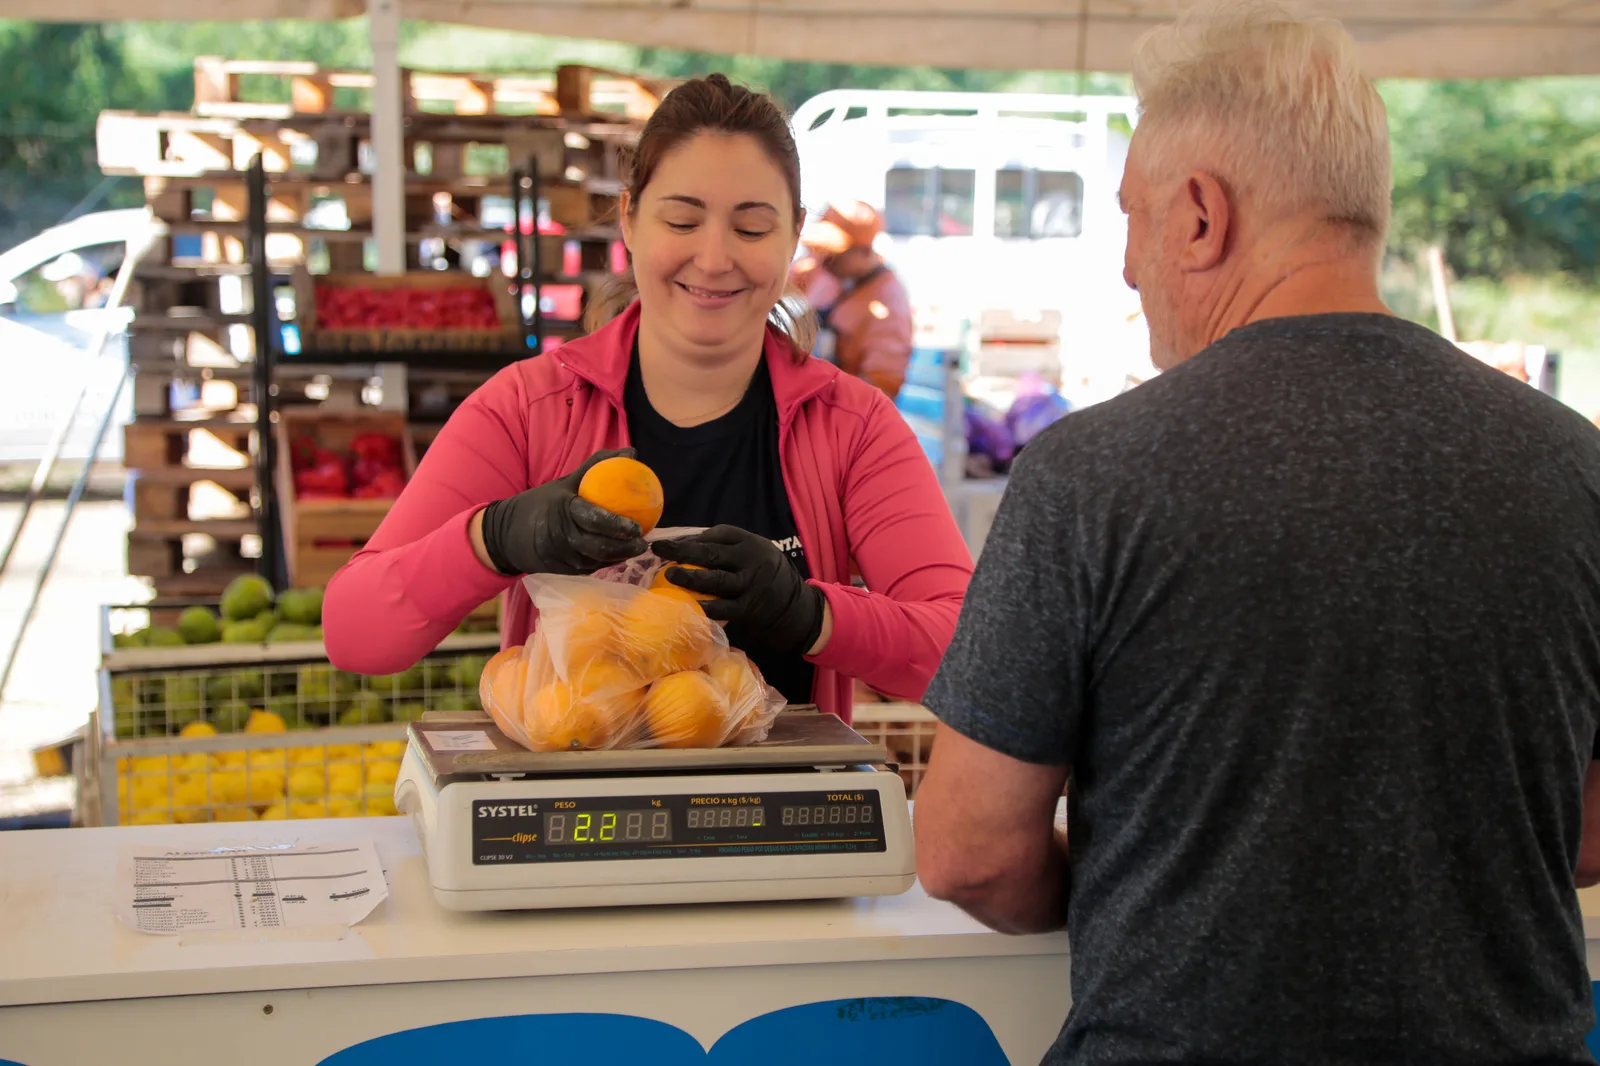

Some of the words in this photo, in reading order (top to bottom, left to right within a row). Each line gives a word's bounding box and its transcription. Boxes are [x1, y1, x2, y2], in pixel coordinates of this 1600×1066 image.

[690, 797, 720, 805] PRECIO
[727, 797, 738, 805] kg
[738, 796, 761, 805] ($/kg)
[853, 794, 864, 802] ($)
[554, 801, 576, 809] PESO
[651, 799, 662, 807] kg
[511, 832, 537, 844] clipse
